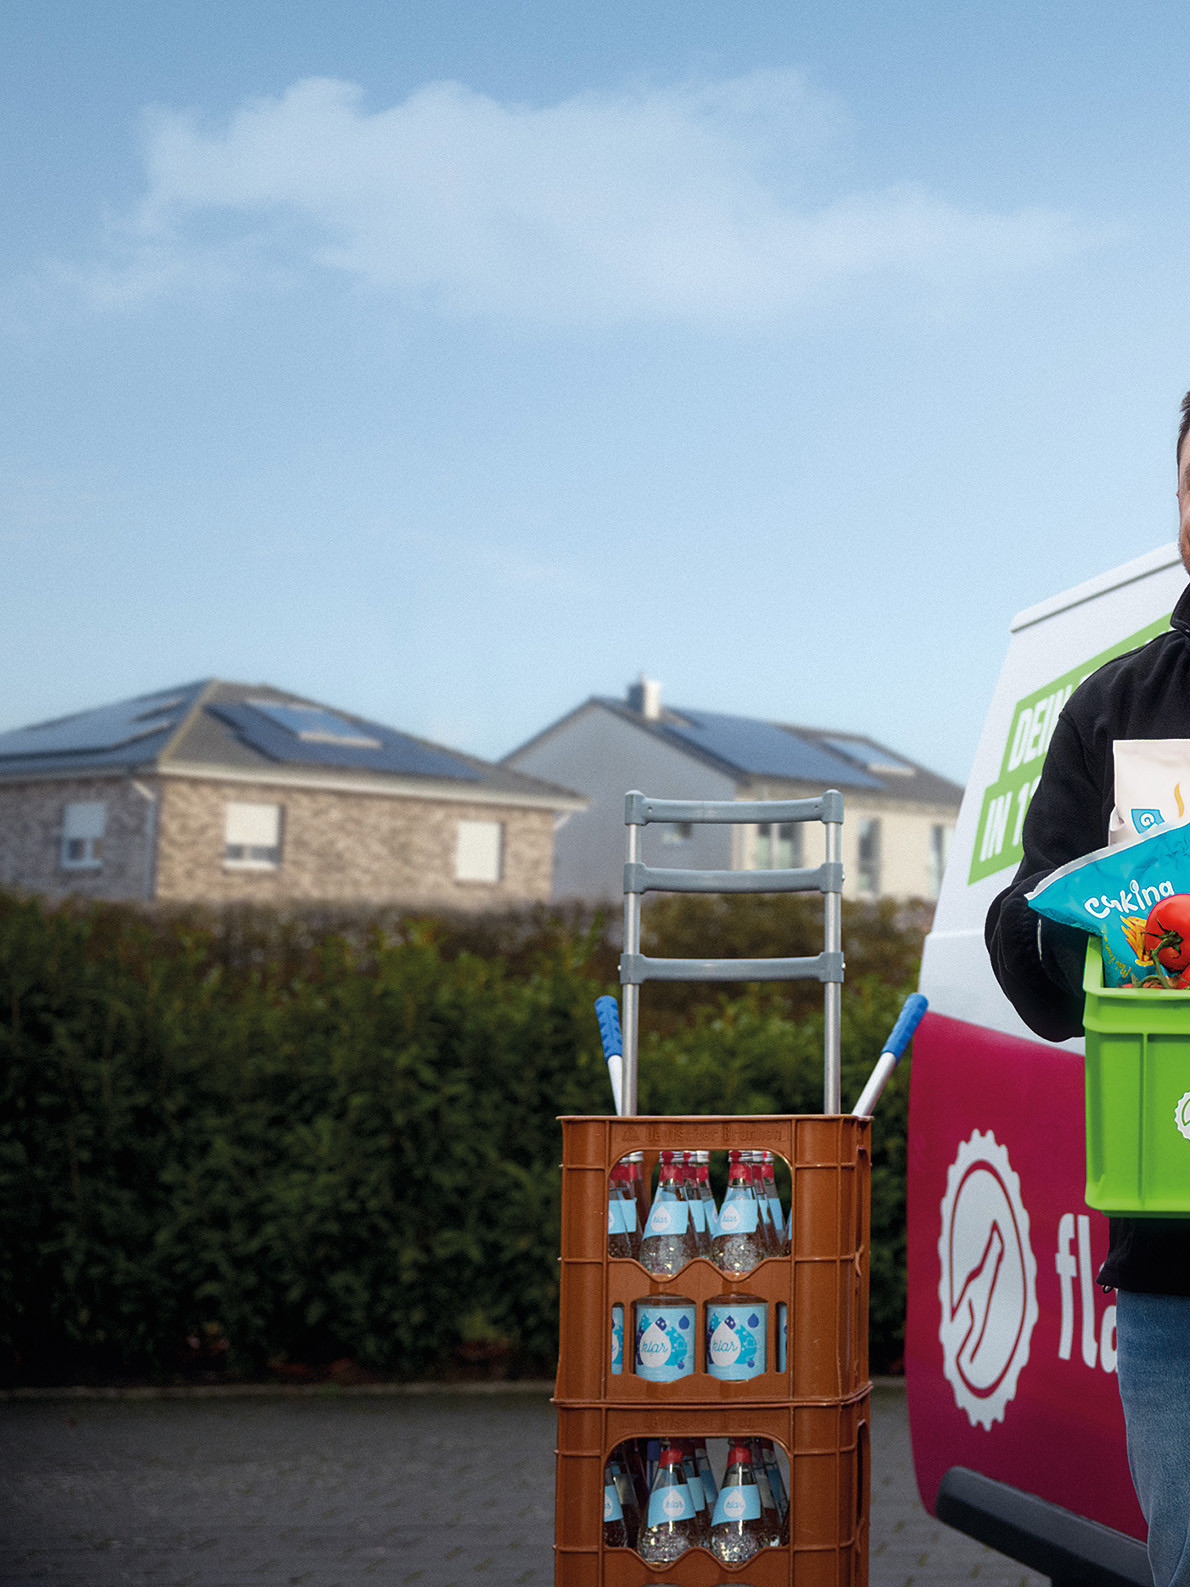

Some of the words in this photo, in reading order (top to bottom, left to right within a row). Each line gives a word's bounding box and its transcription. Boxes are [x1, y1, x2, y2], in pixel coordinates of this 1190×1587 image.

[980, 791, 1013, 861] IN
[641, 1340, 670, 1354] klar
[712, 1338, 739, 1352] klar
